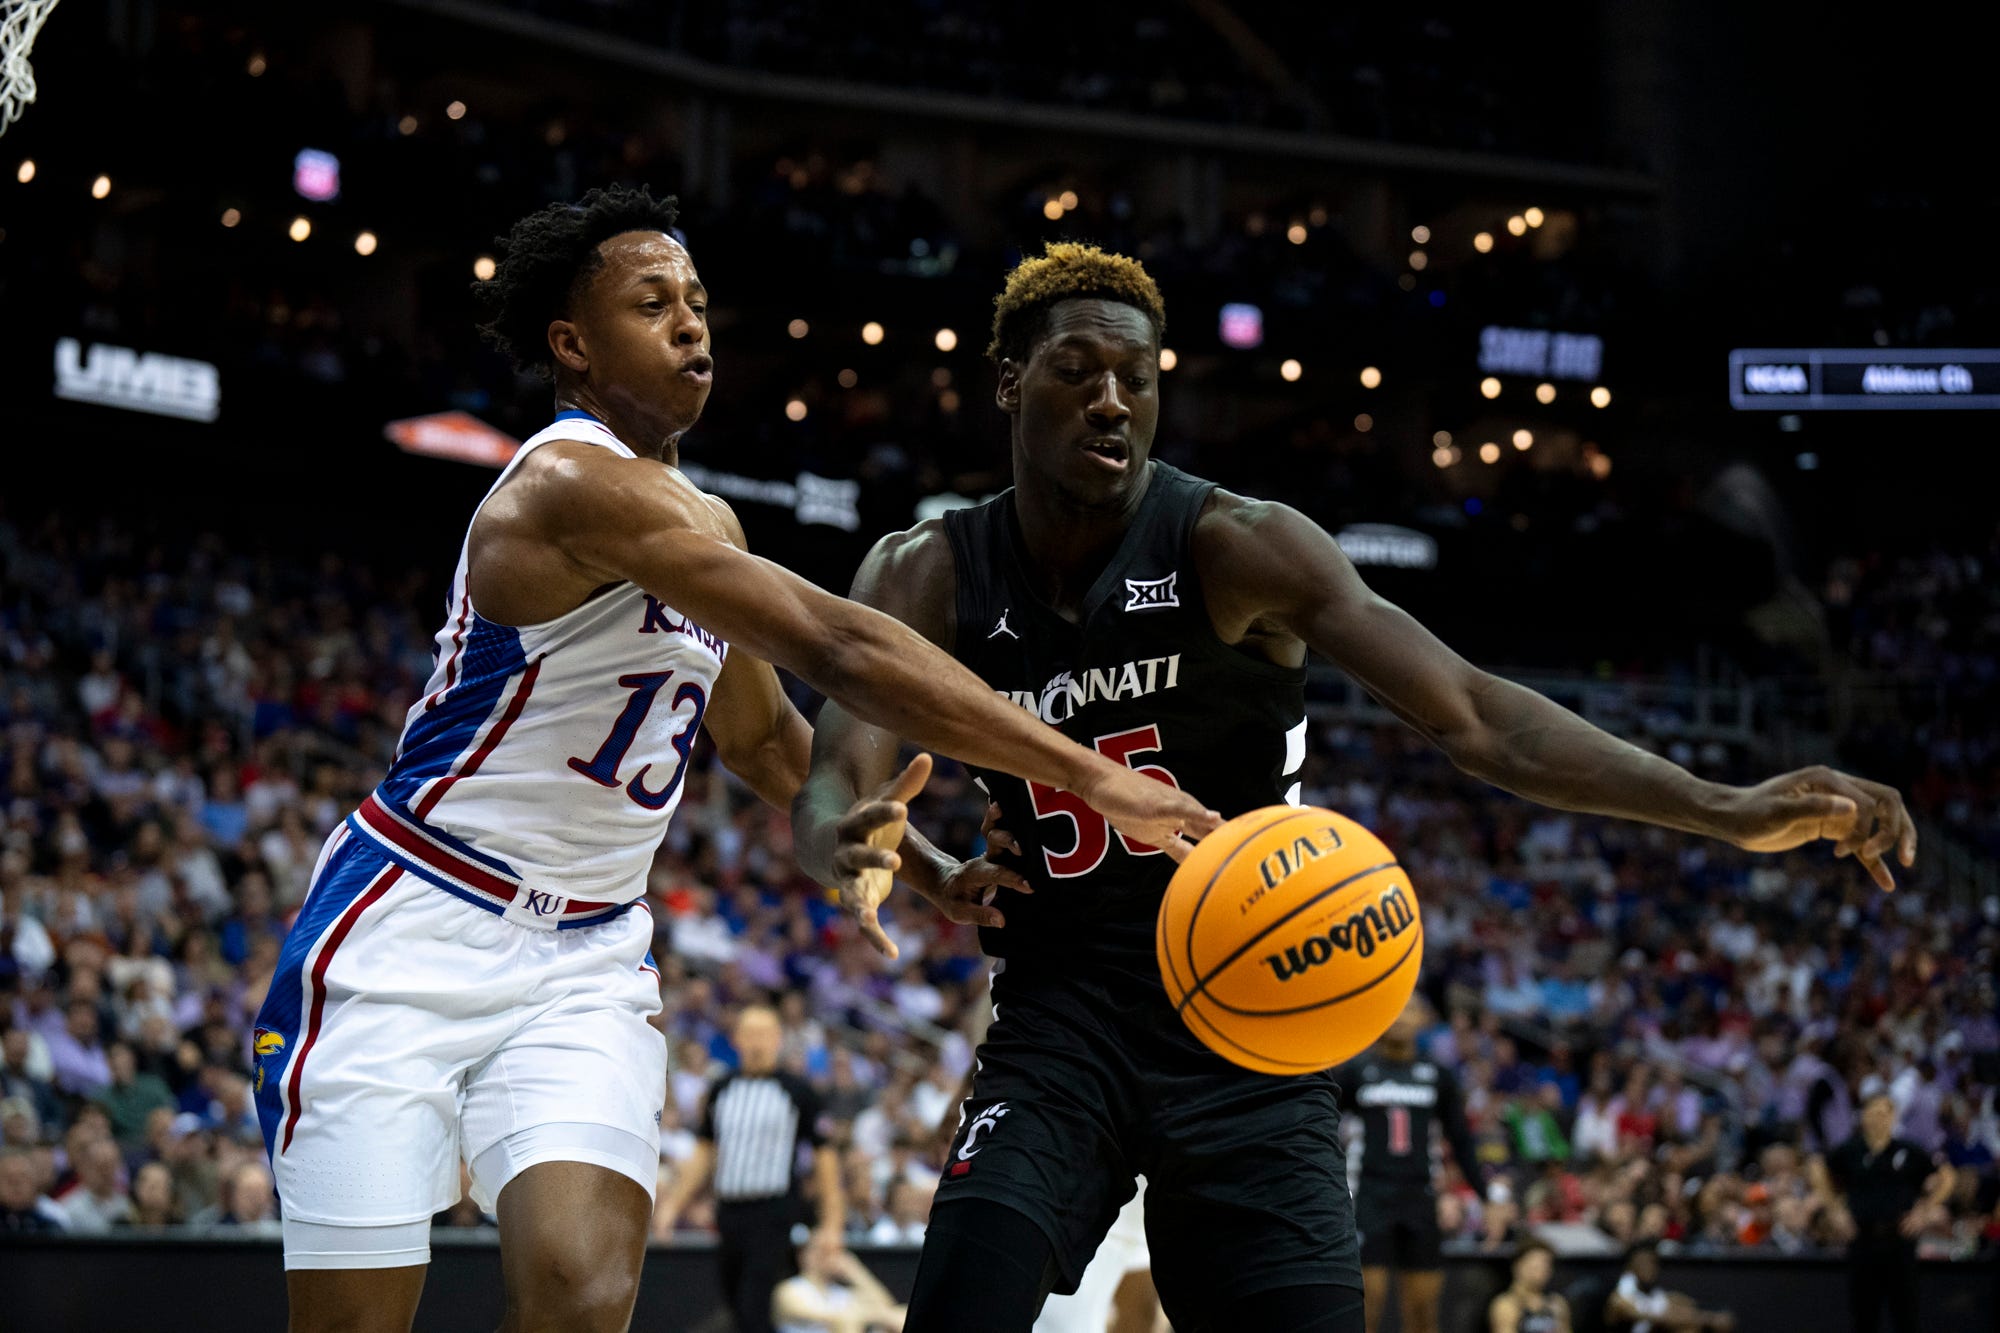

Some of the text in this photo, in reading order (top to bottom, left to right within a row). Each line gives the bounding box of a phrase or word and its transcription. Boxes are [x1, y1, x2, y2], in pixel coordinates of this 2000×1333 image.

[995, 653, 1181, 725] NCNNATI
[566, 670, 706, 810] 13
[1258, 826, 1345, 890] EVO
[521, 887, 564, 917] KU
[1264, 883, 1415, 983] Wilson
